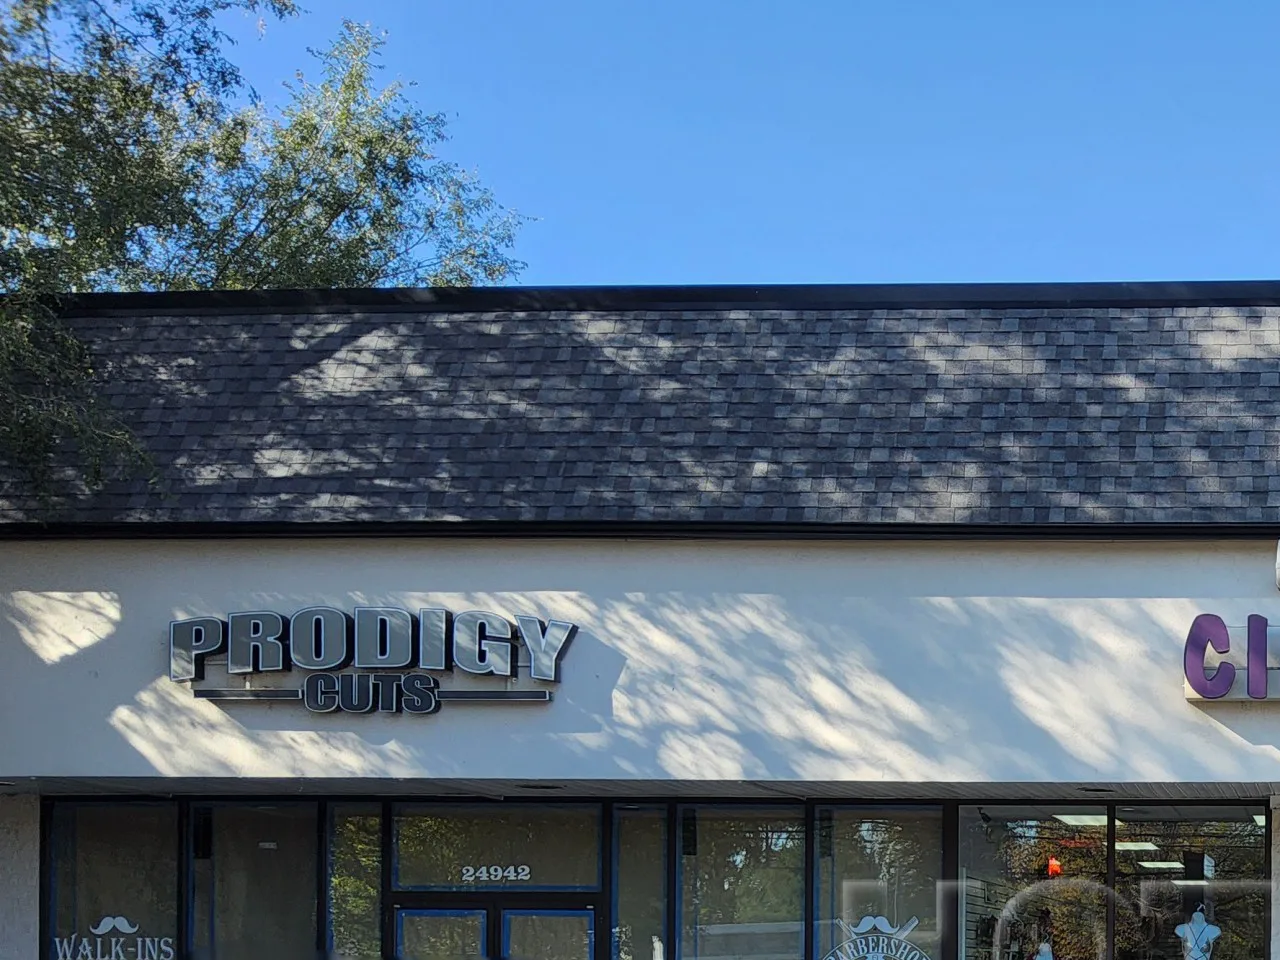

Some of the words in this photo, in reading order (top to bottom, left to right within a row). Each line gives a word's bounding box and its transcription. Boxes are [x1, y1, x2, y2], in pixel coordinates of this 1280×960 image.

[169, 605, 580, 682] PRODIGY
[303, 672, 441, 714] CUTS
[461, 864, 532, 881] 24942
[54, 932, 174, 960] WALK-INS
